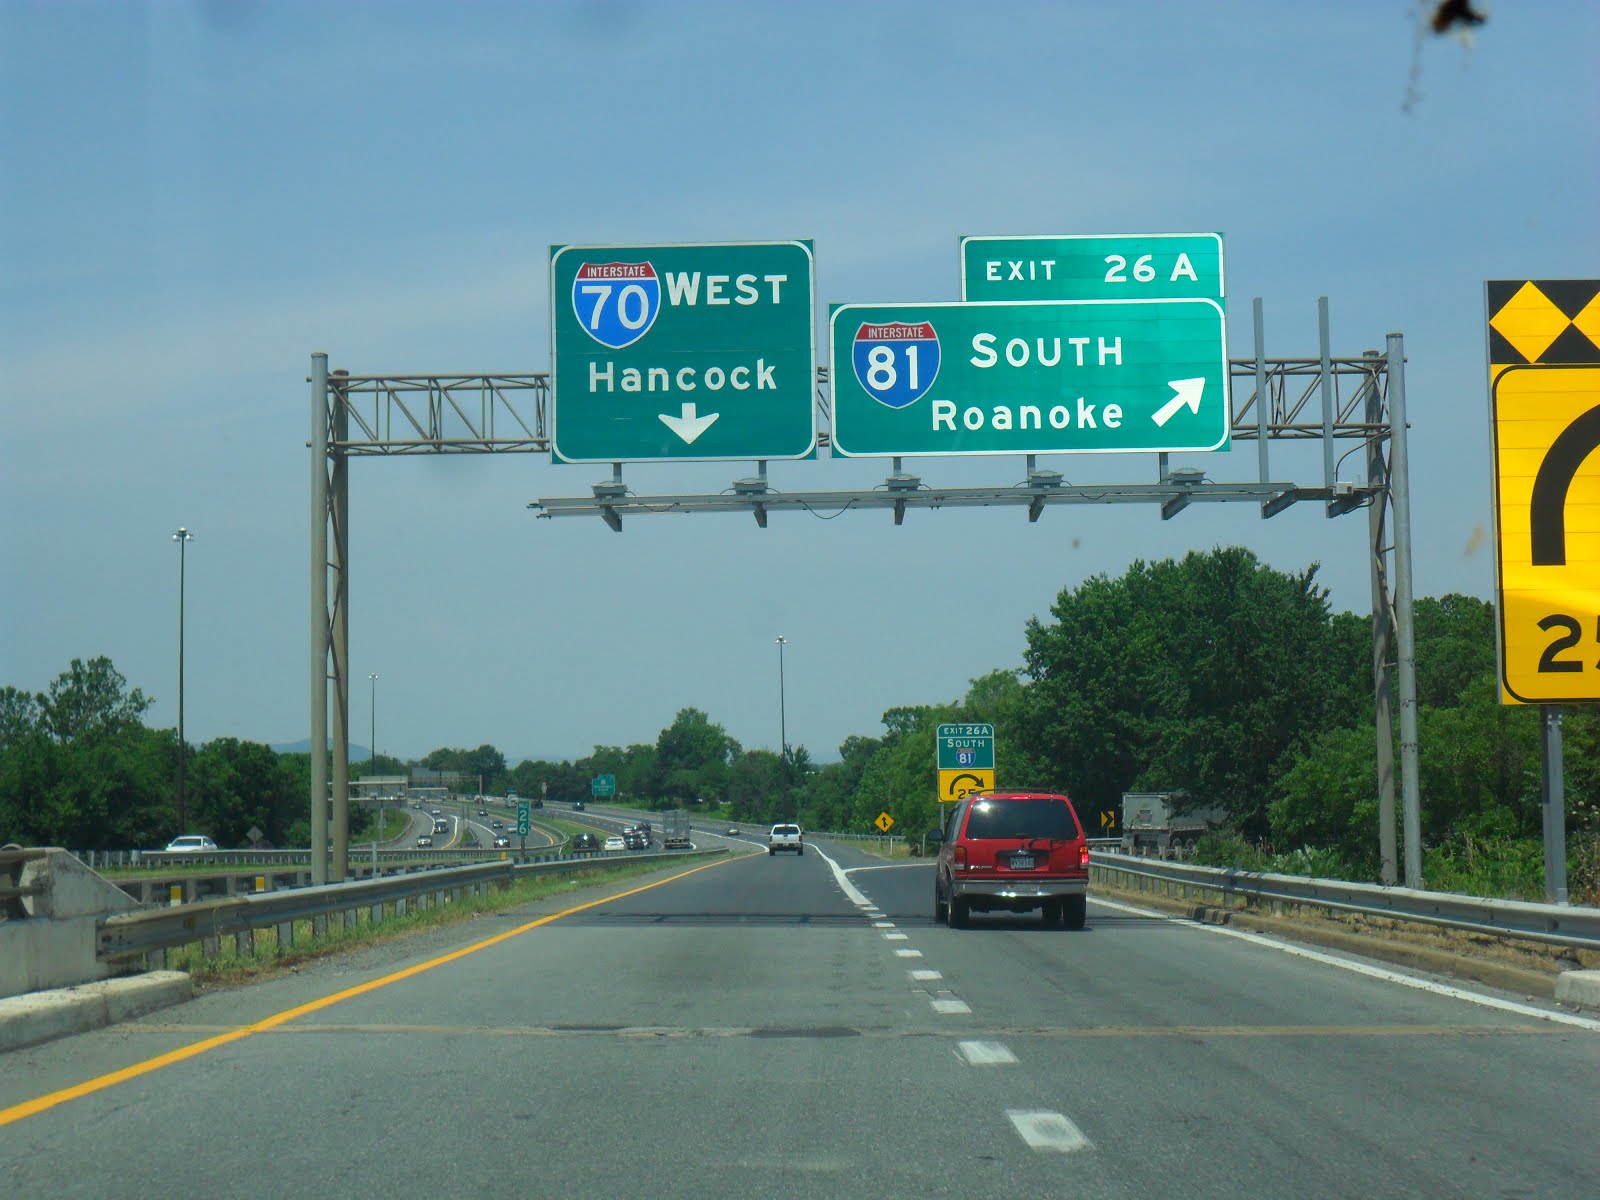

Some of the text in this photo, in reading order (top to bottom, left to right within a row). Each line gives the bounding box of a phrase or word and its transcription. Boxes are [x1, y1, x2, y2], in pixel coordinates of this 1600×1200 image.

[587, 266, 646, 277] INTERSTATE
[987, 253, 1198, 283] EXIT 26 A
[665, 271, 788, 306] WEST
[581, 284, 649, 330] 70
[868, 327, 924, 338] INTERSTATE
[970, 332, 1122, 368] SOUTH
[589, 358, 777, 393] Hancock
[867, 345, 918, 391] 81
[932, 397, 1123, 431] Roanoke
[1537, 614, 1600, 673] 2
[947, 739, 985, 748] SOUTH
[966, 727, 989, 735] 26A
[959, 753, 971, 764] 81
